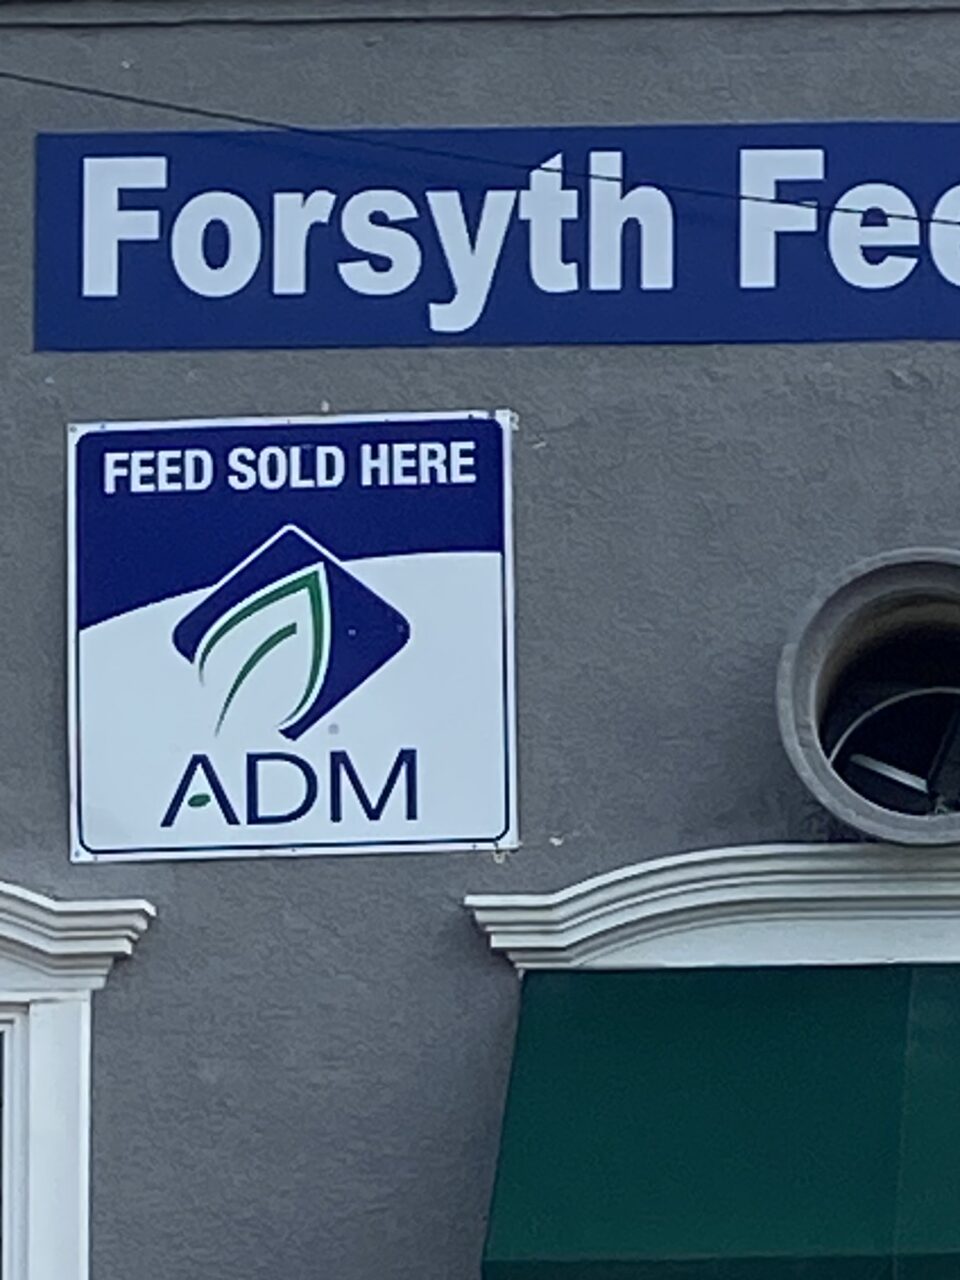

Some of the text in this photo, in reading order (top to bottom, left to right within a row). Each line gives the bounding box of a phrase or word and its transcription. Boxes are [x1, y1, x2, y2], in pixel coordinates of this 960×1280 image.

[81, 151, 674, 333] Forsyth
[104, 441, 477, 494] FEED SOLD HERE
[160, 748, 418, 828] ADM
